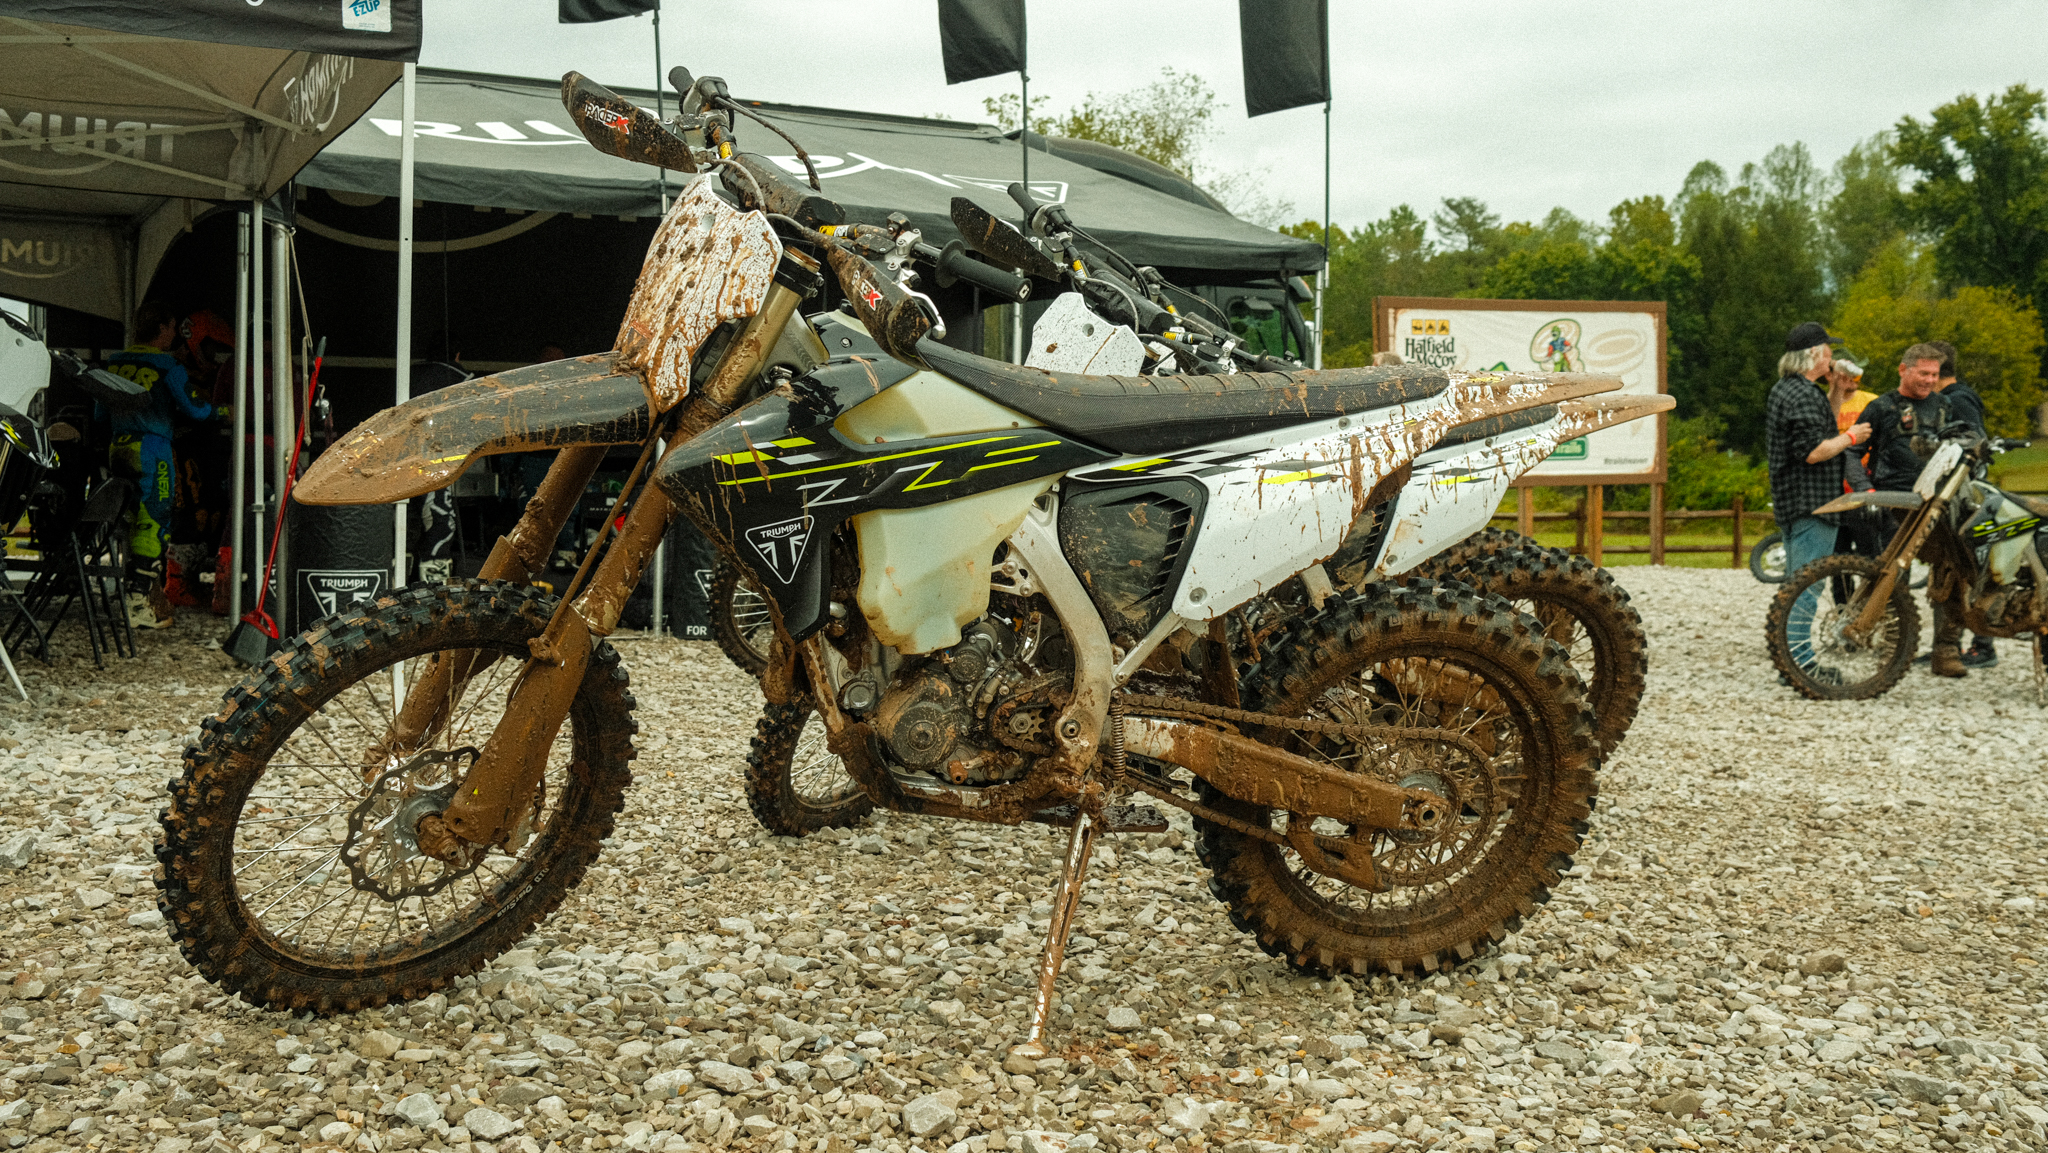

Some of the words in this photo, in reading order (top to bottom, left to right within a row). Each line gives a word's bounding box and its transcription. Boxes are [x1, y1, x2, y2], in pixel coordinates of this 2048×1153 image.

[1405, 336, 1455, 359] Hatfield
[760, 523, 801, 538] TRIUMPH
[320, 579, 368, 591] TRIUMPH
[686, 626, 708, 636] FOR
